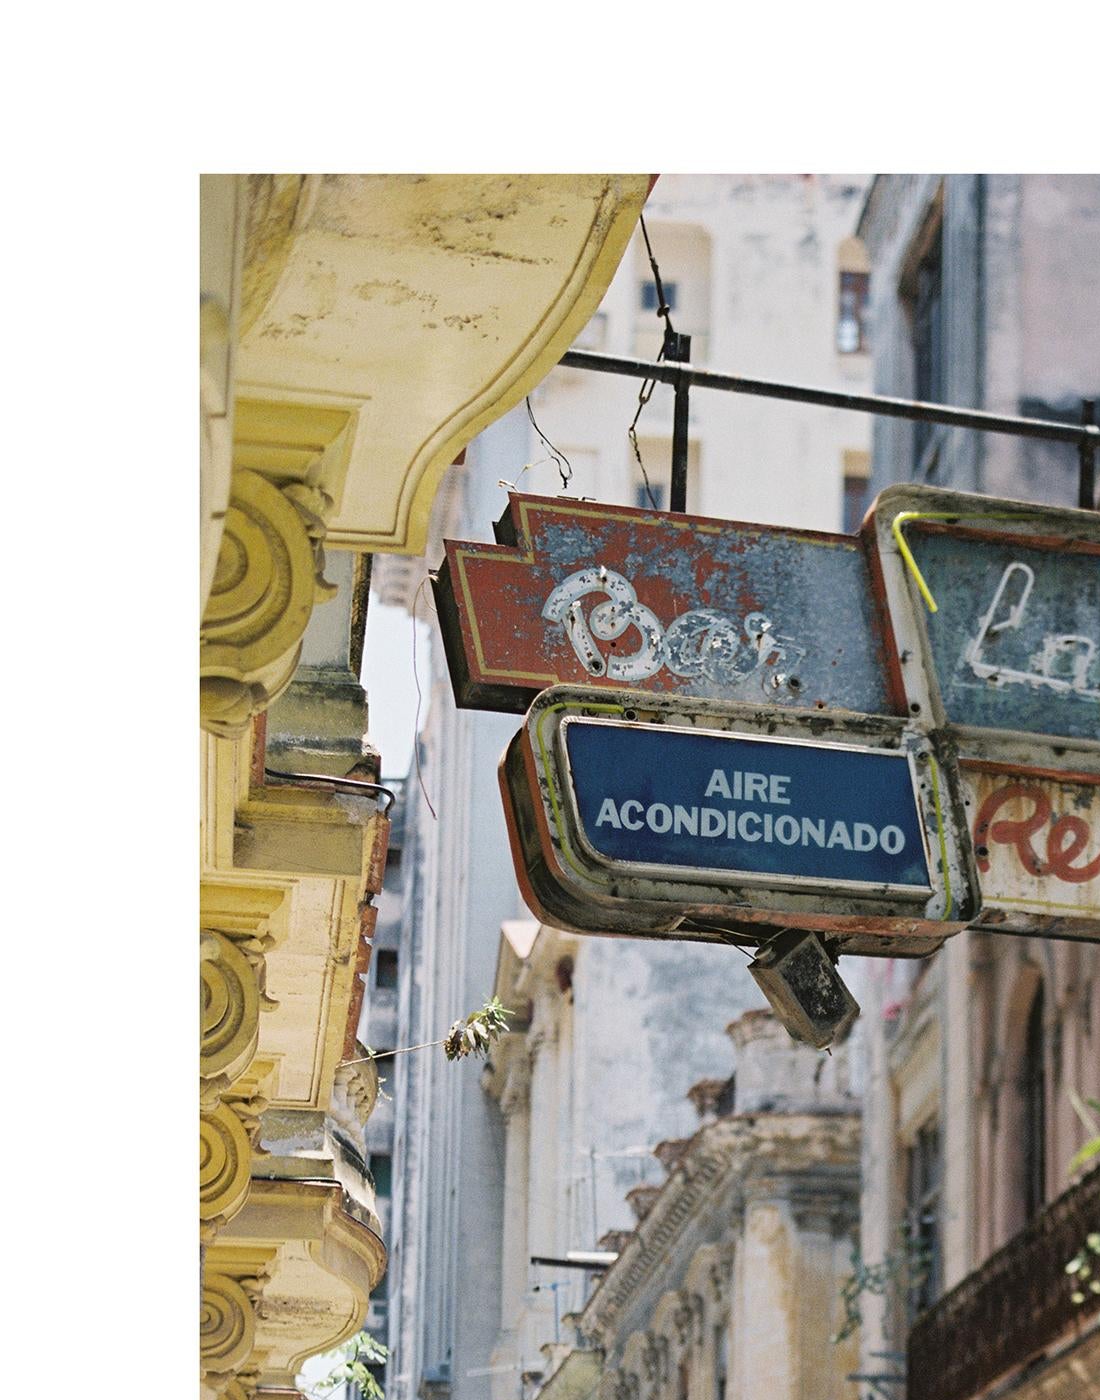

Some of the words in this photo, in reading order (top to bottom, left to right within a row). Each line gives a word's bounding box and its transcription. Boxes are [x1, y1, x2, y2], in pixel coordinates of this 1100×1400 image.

[542, 568, 804, 690] Bar
[704, 768, 792, 804] AIRE
[596, 798, 905, 855] ACONDICIONADO
